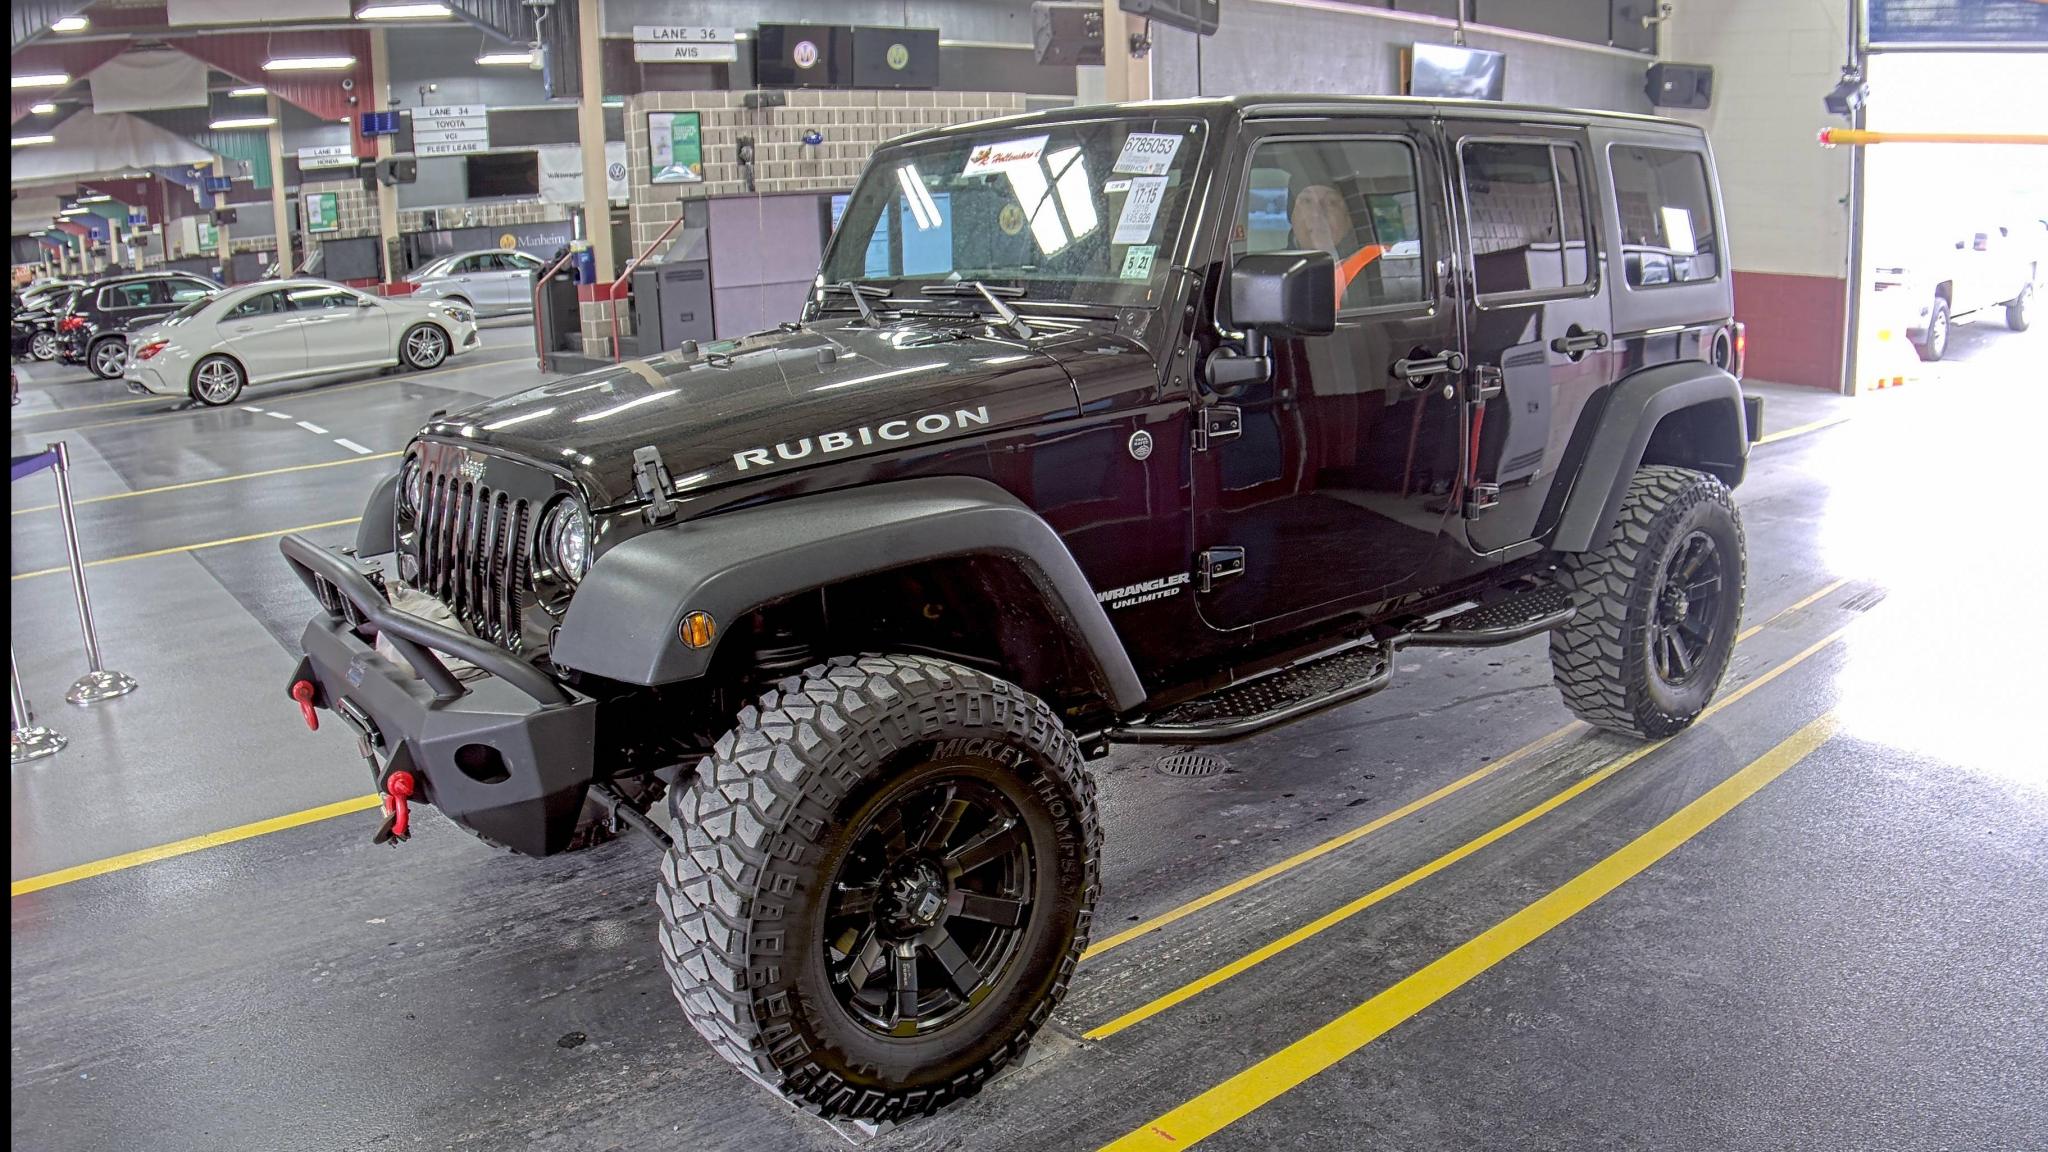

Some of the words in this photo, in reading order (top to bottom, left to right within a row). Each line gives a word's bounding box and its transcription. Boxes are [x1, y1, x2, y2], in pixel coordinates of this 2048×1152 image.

[653, 29, 687, 39] LANE
[700, 29, 716, 39] 36
[674, 47, 698, 57] AVIS
[430, 107, 451, 115] LANE
[453, 144, 477, 152] LEASE
[1124, 136, 1175, 154] 6785053
[518, 233, 565, 247] Manheim
[1128, 257, 1134, 270] 5
[1138, 256, 1149, 270] 21
[733, 406, 990, 471] RUBICON
[1096, 572, 1190, 603] WRANGLER
[1112, 587, 1180, 610] UNLIMITED
[930, 738, 1032, 770] MICKEY
